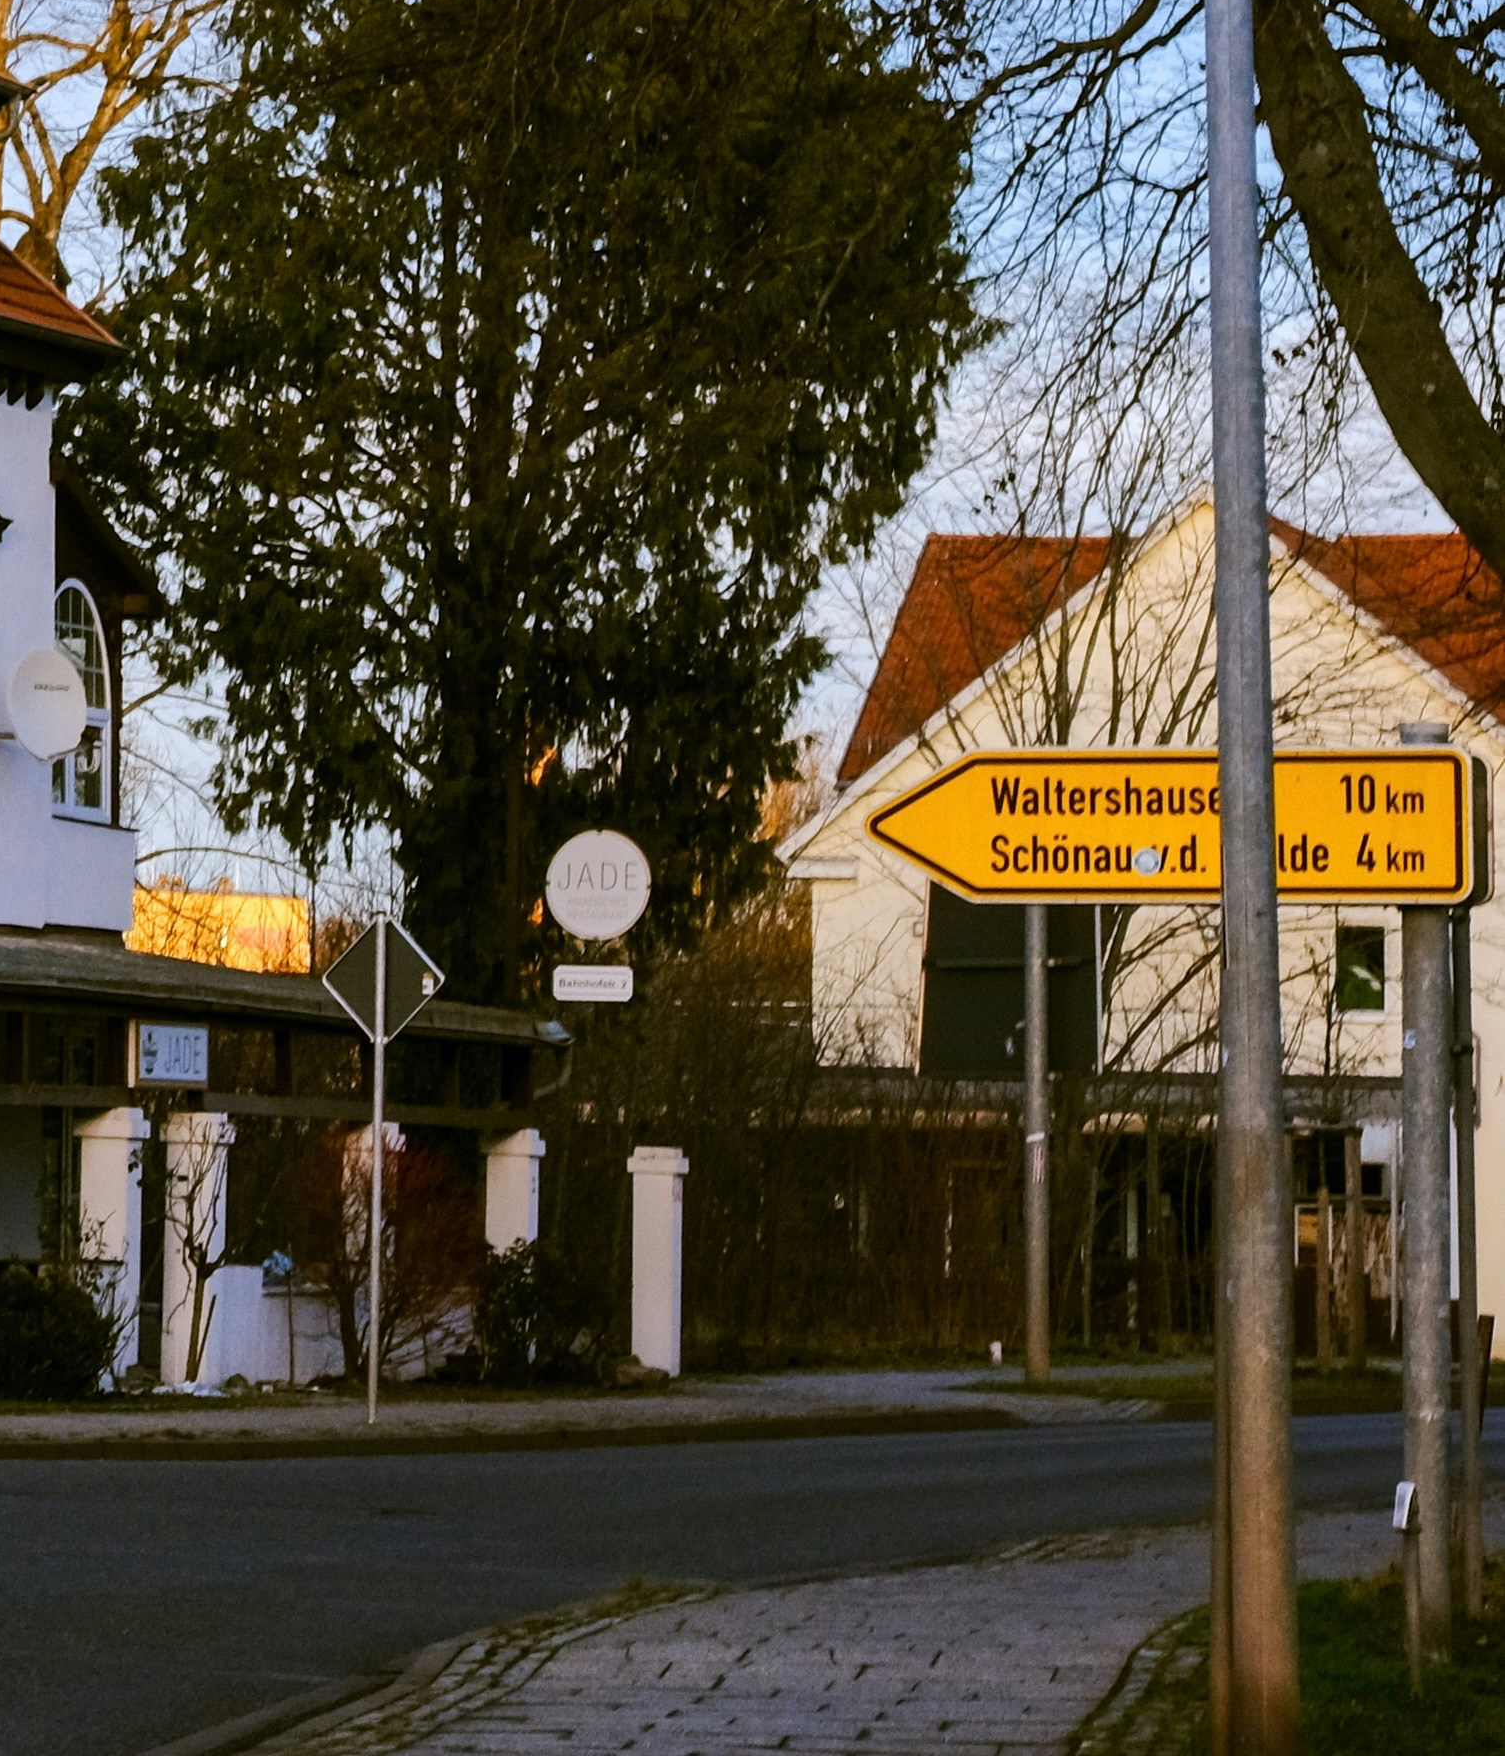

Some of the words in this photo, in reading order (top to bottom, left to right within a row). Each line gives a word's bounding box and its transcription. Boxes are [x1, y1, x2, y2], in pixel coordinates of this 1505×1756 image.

[990, 776, 1221, 816] Waltershause
[1340, 773, 1375, 814] 10
[1385, 784, 1425, 814] km
[990, 834, 1133, 874] Schönau
[1356, 832, 1376, 872] 4
[1386, 844, 1425, 873] km
[557, 861, 638, 891] JADE
[164, 1035, 201, 1075] JADE
